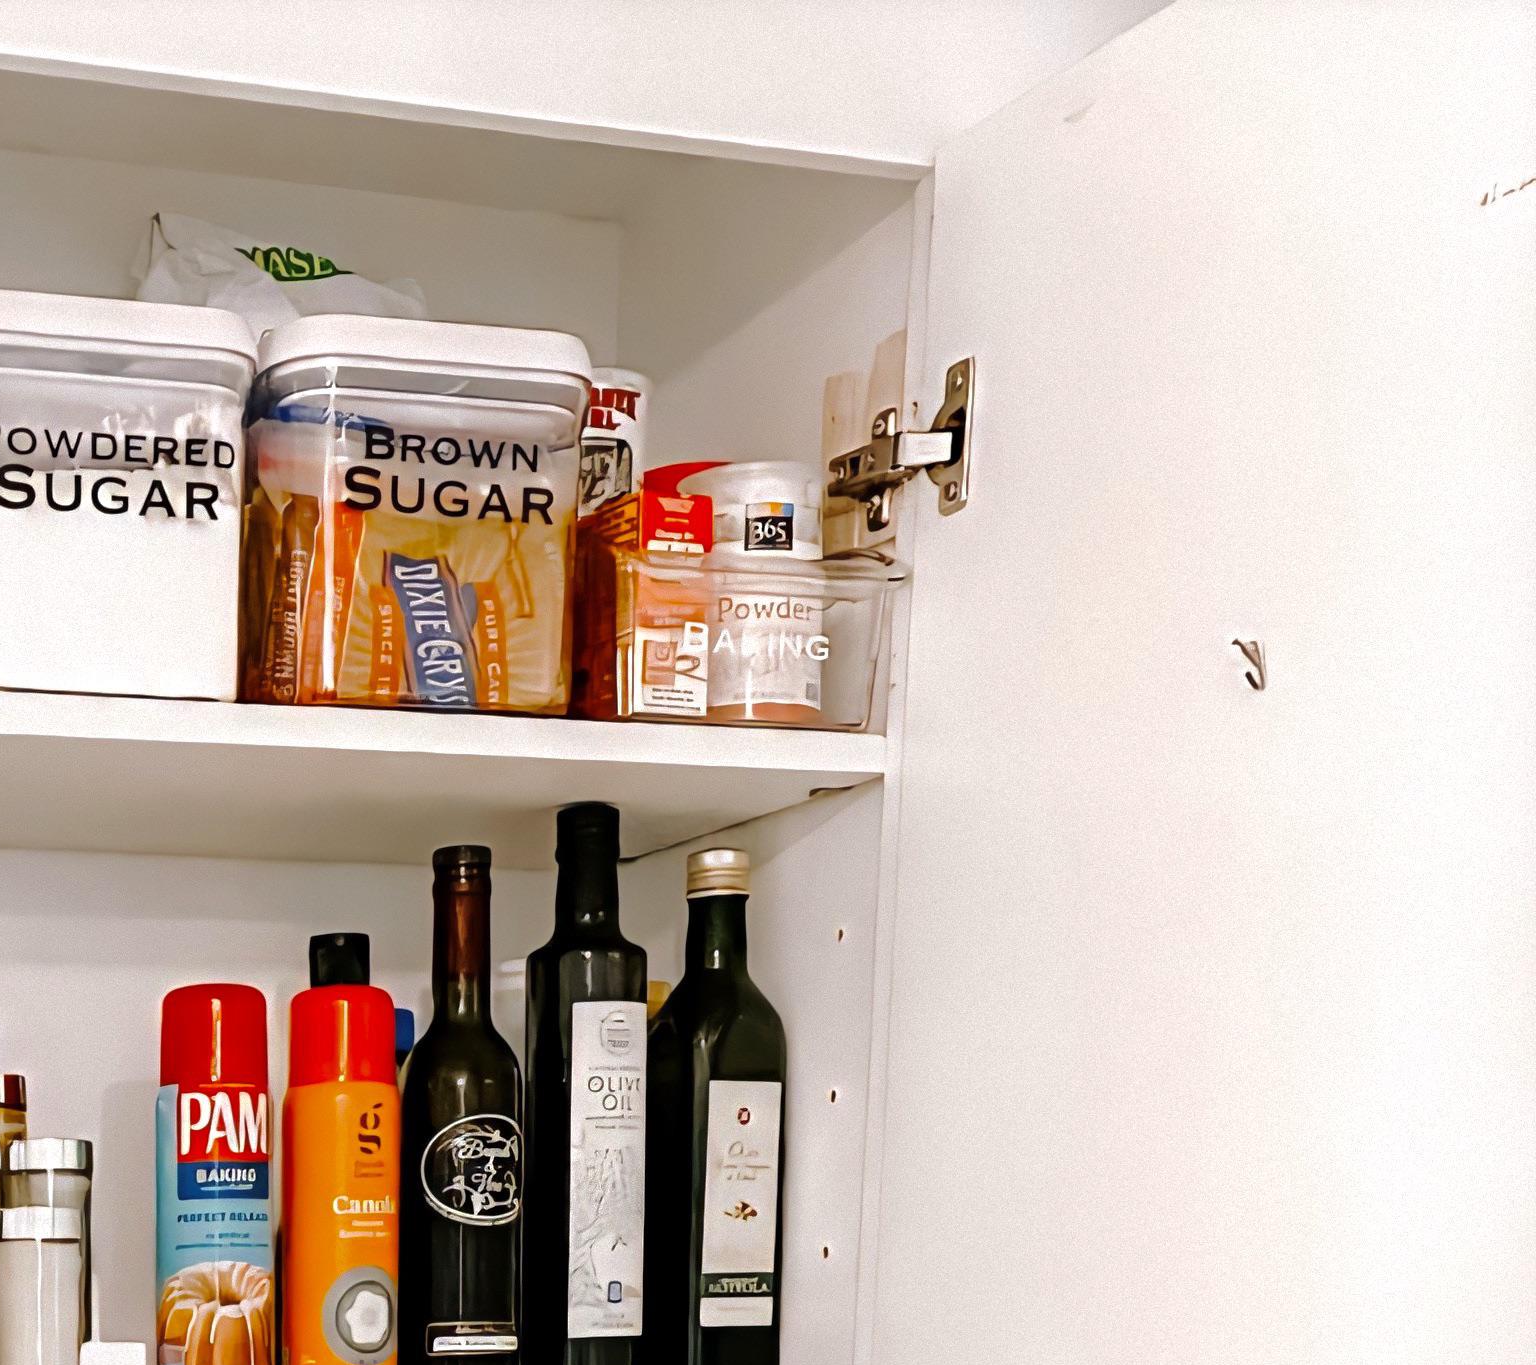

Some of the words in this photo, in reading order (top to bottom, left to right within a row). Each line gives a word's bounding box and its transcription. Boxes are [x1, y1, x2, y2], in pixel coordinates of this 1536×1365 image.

[363, 427, 539, 473] BROWN
[344, 467, 554, 525] SUGAR
[751, 518, 787, 543] 365
[394, 563, 453, 634] DIXIE
[717, 597, 813, 623] Powder
[180, 1091, 268, 1156] PAM
